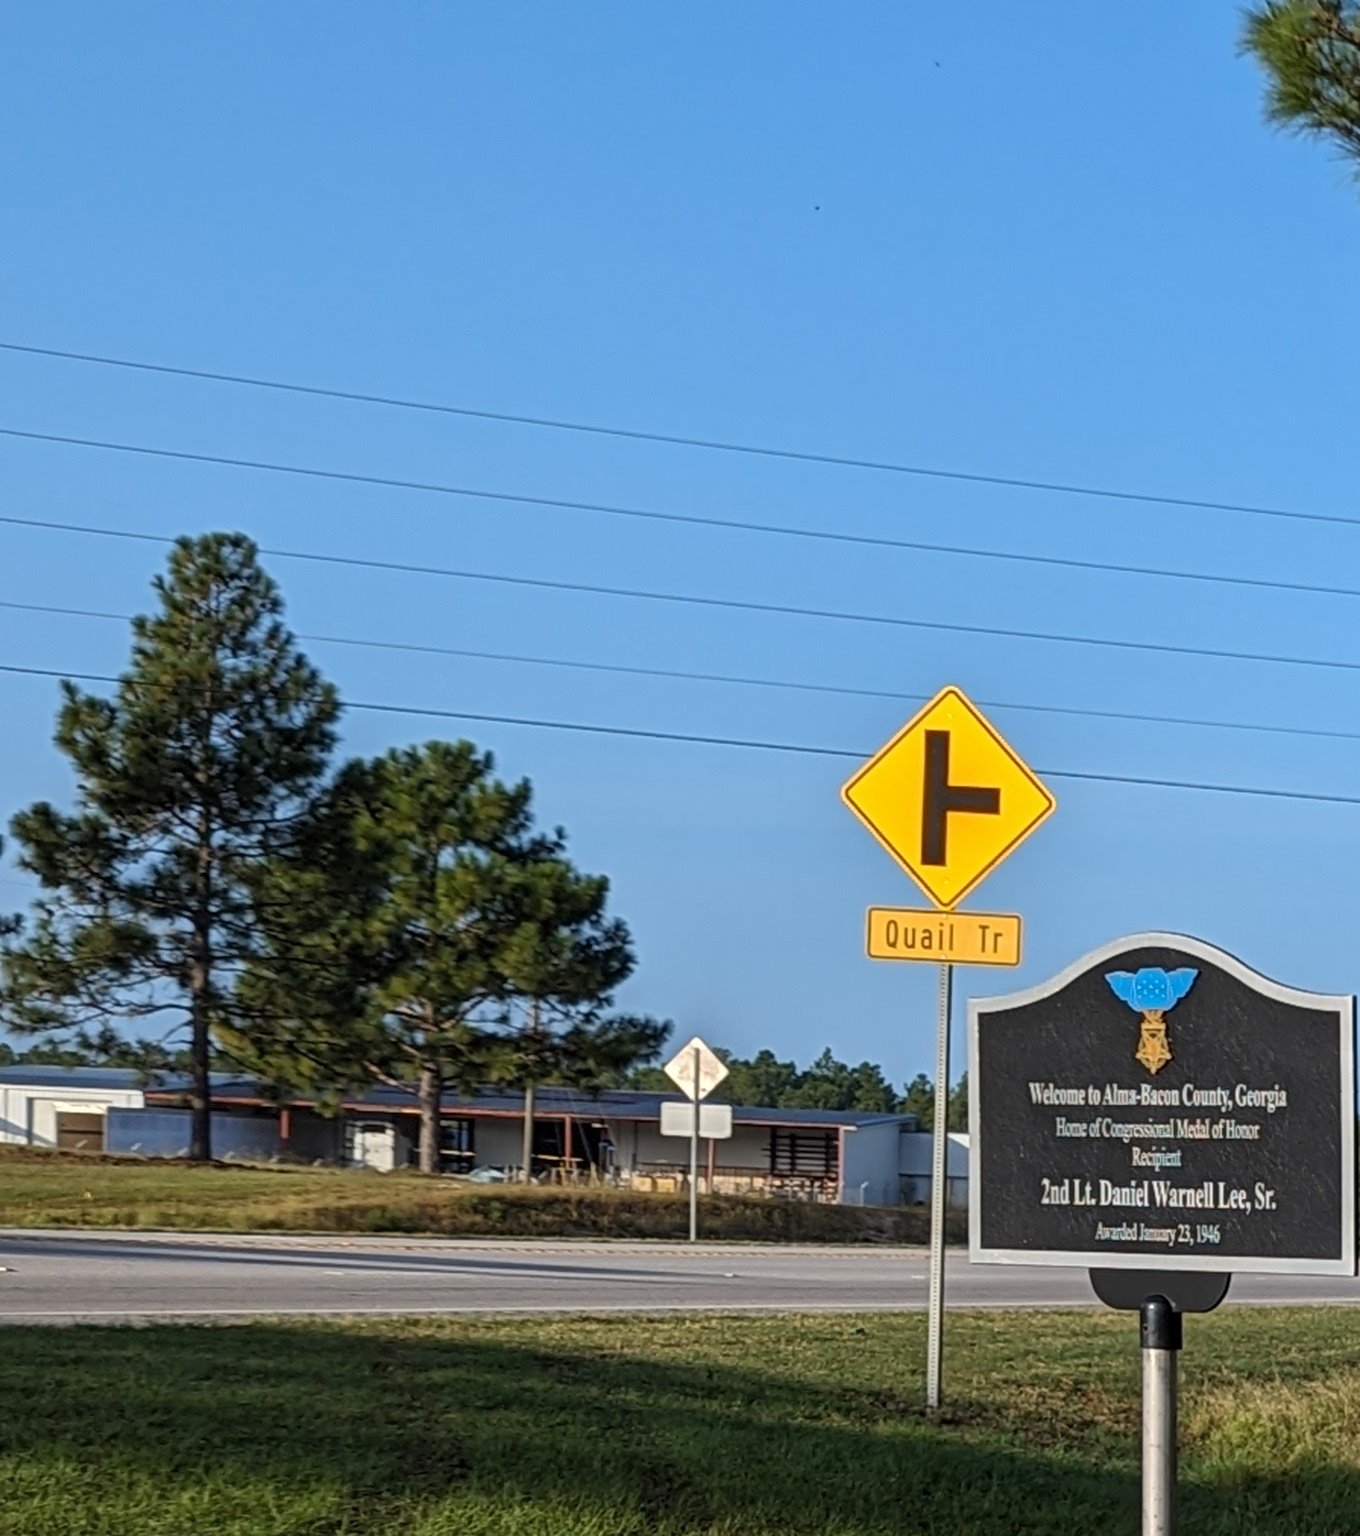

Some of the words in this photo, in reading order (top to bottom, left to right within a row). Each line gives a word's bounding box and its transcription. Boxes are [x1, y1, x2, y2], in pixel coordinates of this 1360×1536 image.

[886, 919, 954, 951] Quail
[979, 925, 1003, 953] Tr
[1028, 1082, 1086, 1105] Welcome
[1087, 1084, 1101, 1105] to
[1102, 1083, 1180, 1106] Alma-Bacon
[1182, 1083, 1233, 1113] County,
[1235, 1083, 1287, 1113] Georgia
[1056, 1117, 1087, 1138] Home
[1088, 1117, 1103, 1138] of
[1102, 1118, 1174, 1143] Congressional
[1176, 1118, 1210, 1139] Medal
[1211, 1119, 1225, 1139] of
[1226, 1119, 1260, 1140] Honor
[1132, 1145, 1182, 1172] Recipient
[1041, 1177, 1070, 1204] 2nd
[1073, 1178, 1097, 1206] Lt.
[1099, 1179, 1149, 1207] Daniel
[1152, 1180, 1214, 1209] Warnell
[1217, 1181, 1251, 1215] Lee,
[1254, 1181, 1277, 1210] Sr.
[1095, 1222, 1138, 1241] Awarded
[1139, 1223, 1177, 1247] January
[1178, 1224, 1194, 1246] 23,
[1195, 1224, 1220, 1244] 1946
